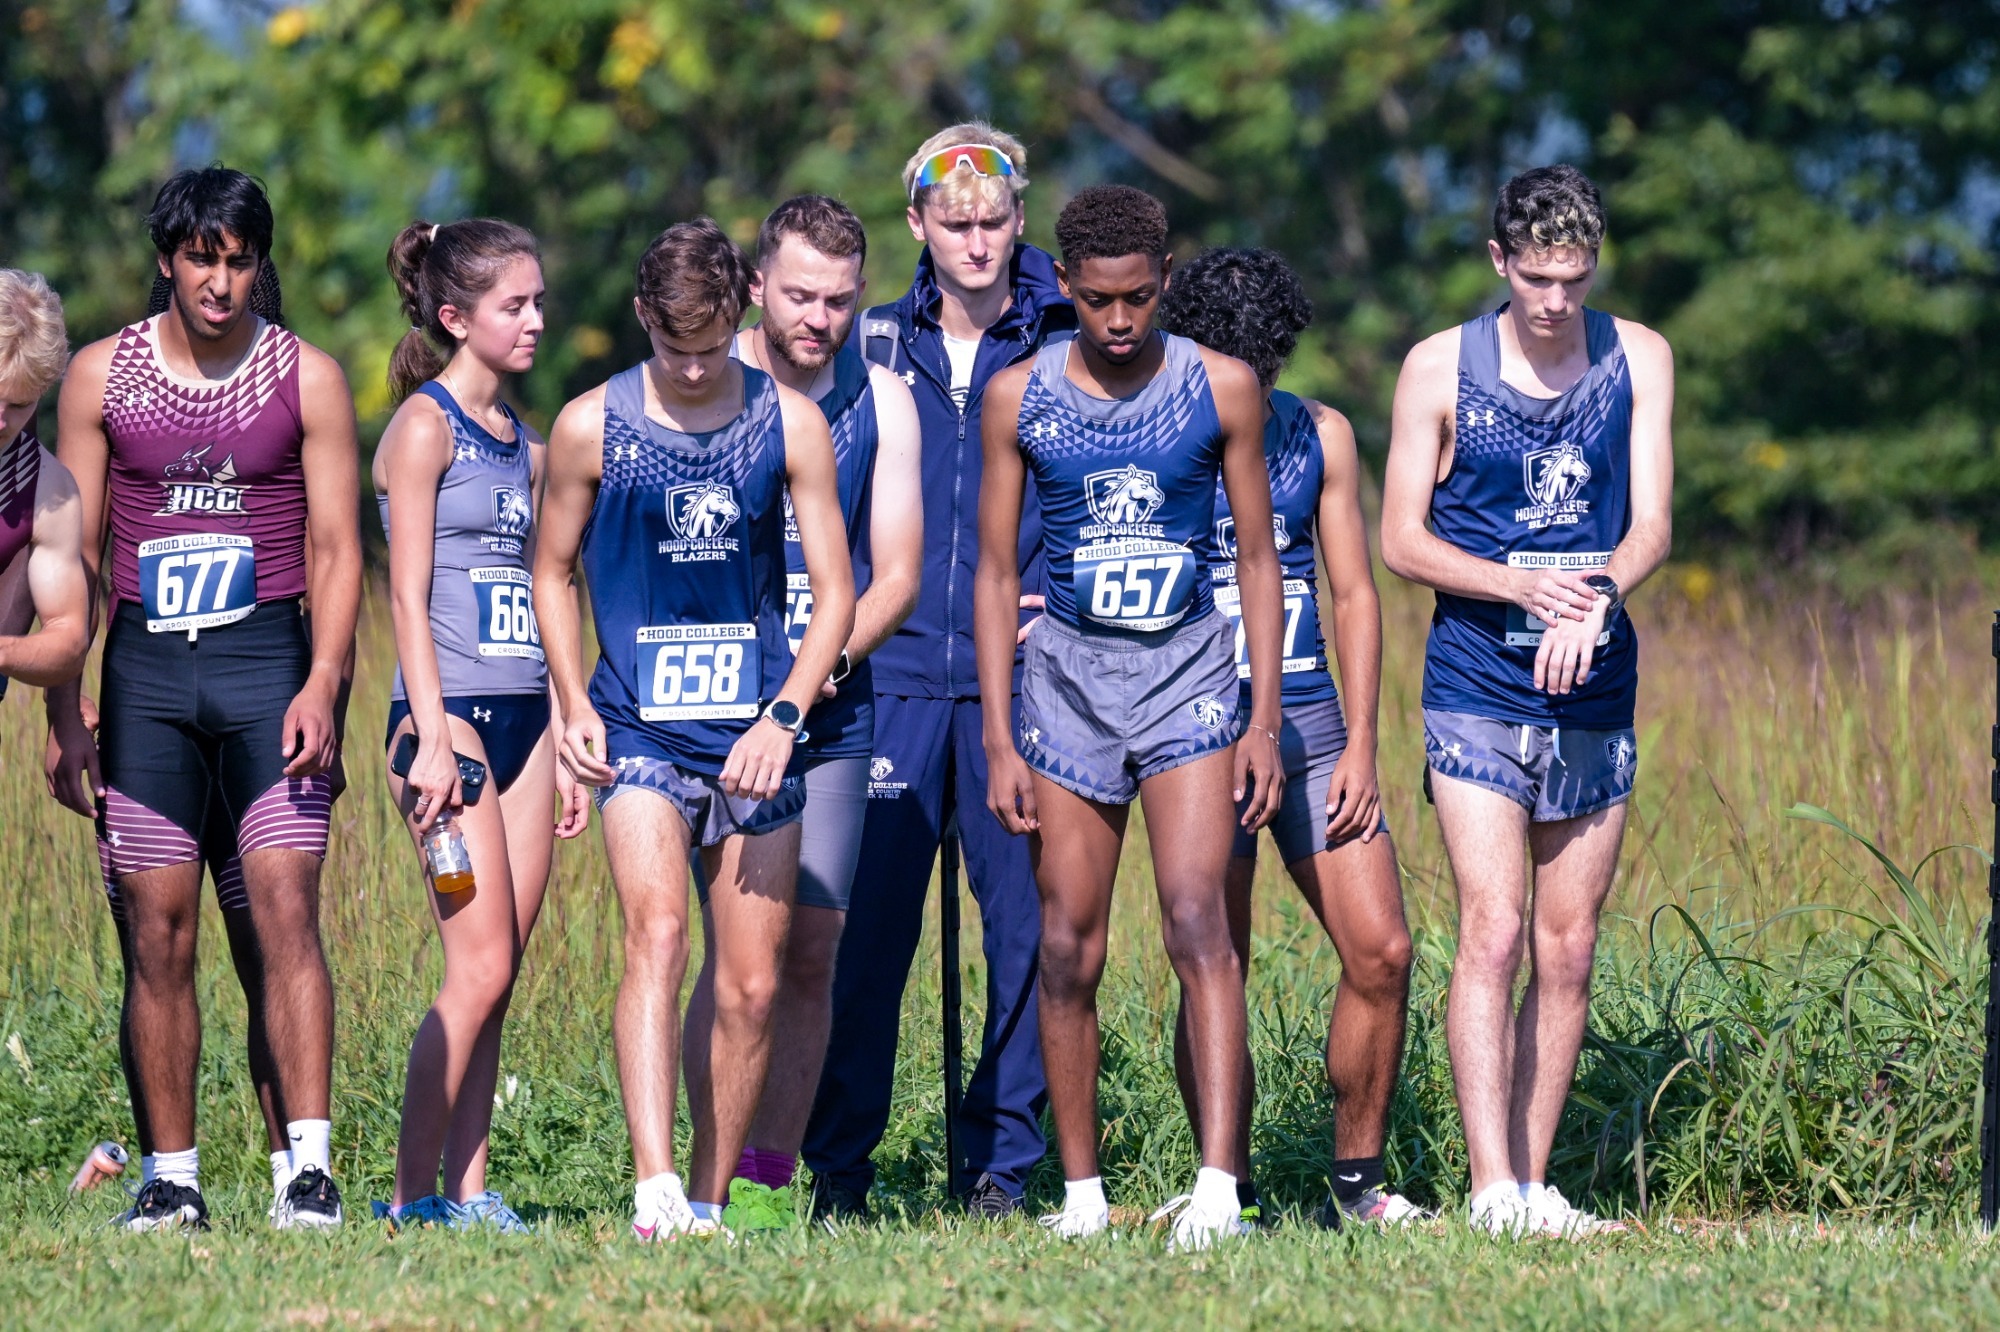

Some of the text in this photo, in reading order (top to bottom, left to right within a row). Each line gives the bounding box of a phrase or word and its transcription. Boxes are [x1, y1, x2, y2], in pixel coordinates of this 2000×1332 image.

[172, 485, 238, 511] HCC
[1515, 499, 1591, 523] HOOD COLLEGE
[1528, 514, 1579, 529] BLAZERS
[1080, 523, 1165, 539] HOOD COLLEGE
[147, 536, 241, 553] HOOD COLLEGE
[658, 537, 739, 554] HOOD COLLEGE
[1085, 543, 1182, 558] HOOD COLLEGE
[671, 551, 726, 563] BLAZERS
[1519, 555, 1556, 566] HOOD
[478, 570, 508, 580] HOOD
[157, 549, 240, 617] 677
[1091, 555, 1184, 618] 657
[166, 613, 238, 629] CROSS COUNTRY
[1134, 618, 1175, 629] COUNTRY
[647, 627, 745, 640] HOOD COLLEGE
[498, 647, 520, 655] CROSS
[652, 643, 744, 705] 658
[695, 709, 737, 717] COUNTRY
